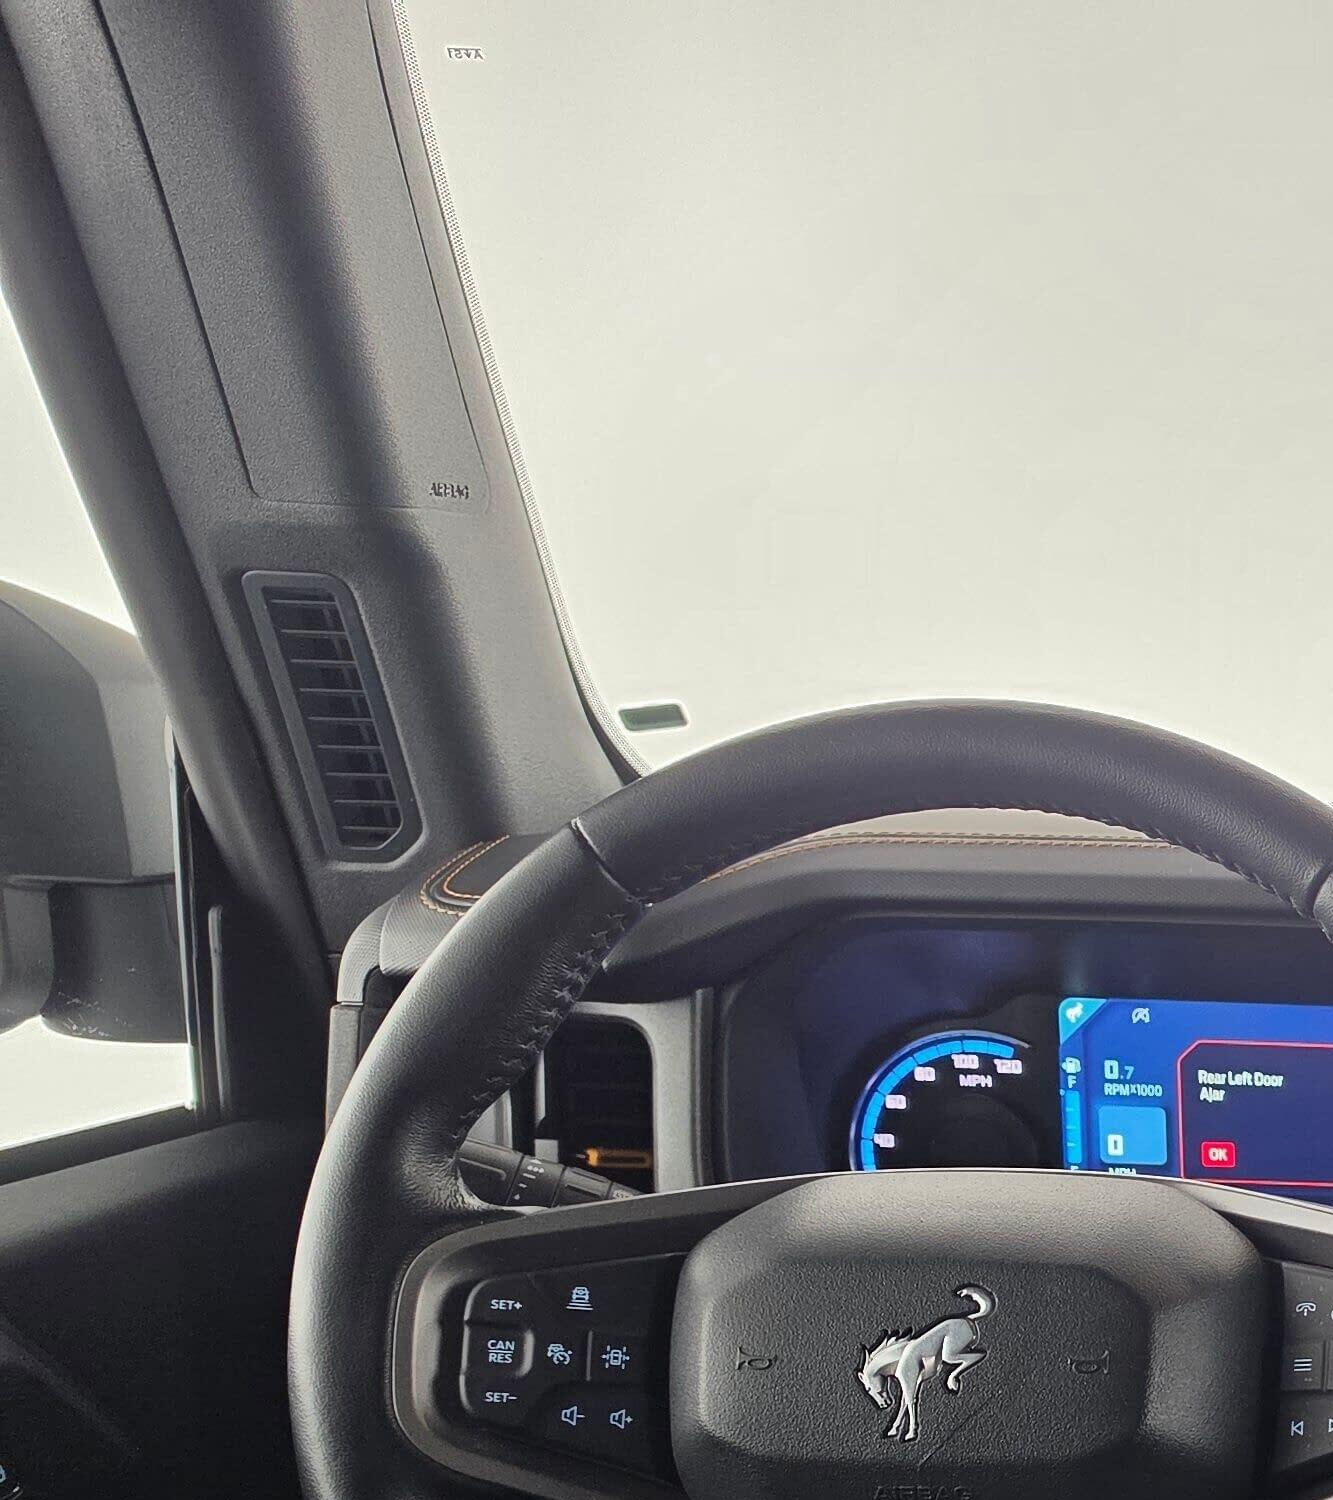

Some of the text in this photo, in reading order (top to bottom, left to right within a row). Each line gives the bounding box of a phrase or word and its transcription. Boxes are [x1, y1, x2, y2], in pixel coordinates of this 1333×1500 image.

[959, 1074, 992, 1088] MPH
[1068, 1075, 1077, 1089] F
[1198, 1070, 1283, 1087] Rear Left Door
[1200, 1087, 1225, 1102] Ajar
[1107, 1134, 1124, 1156] 0
[1209, 1147, 1228, 1162] OK
[487, 1339, 515, 1350] CAN
[488, 1352, 513, 1364] RES
[873, 1485, 972, 1500] AIRBAG
